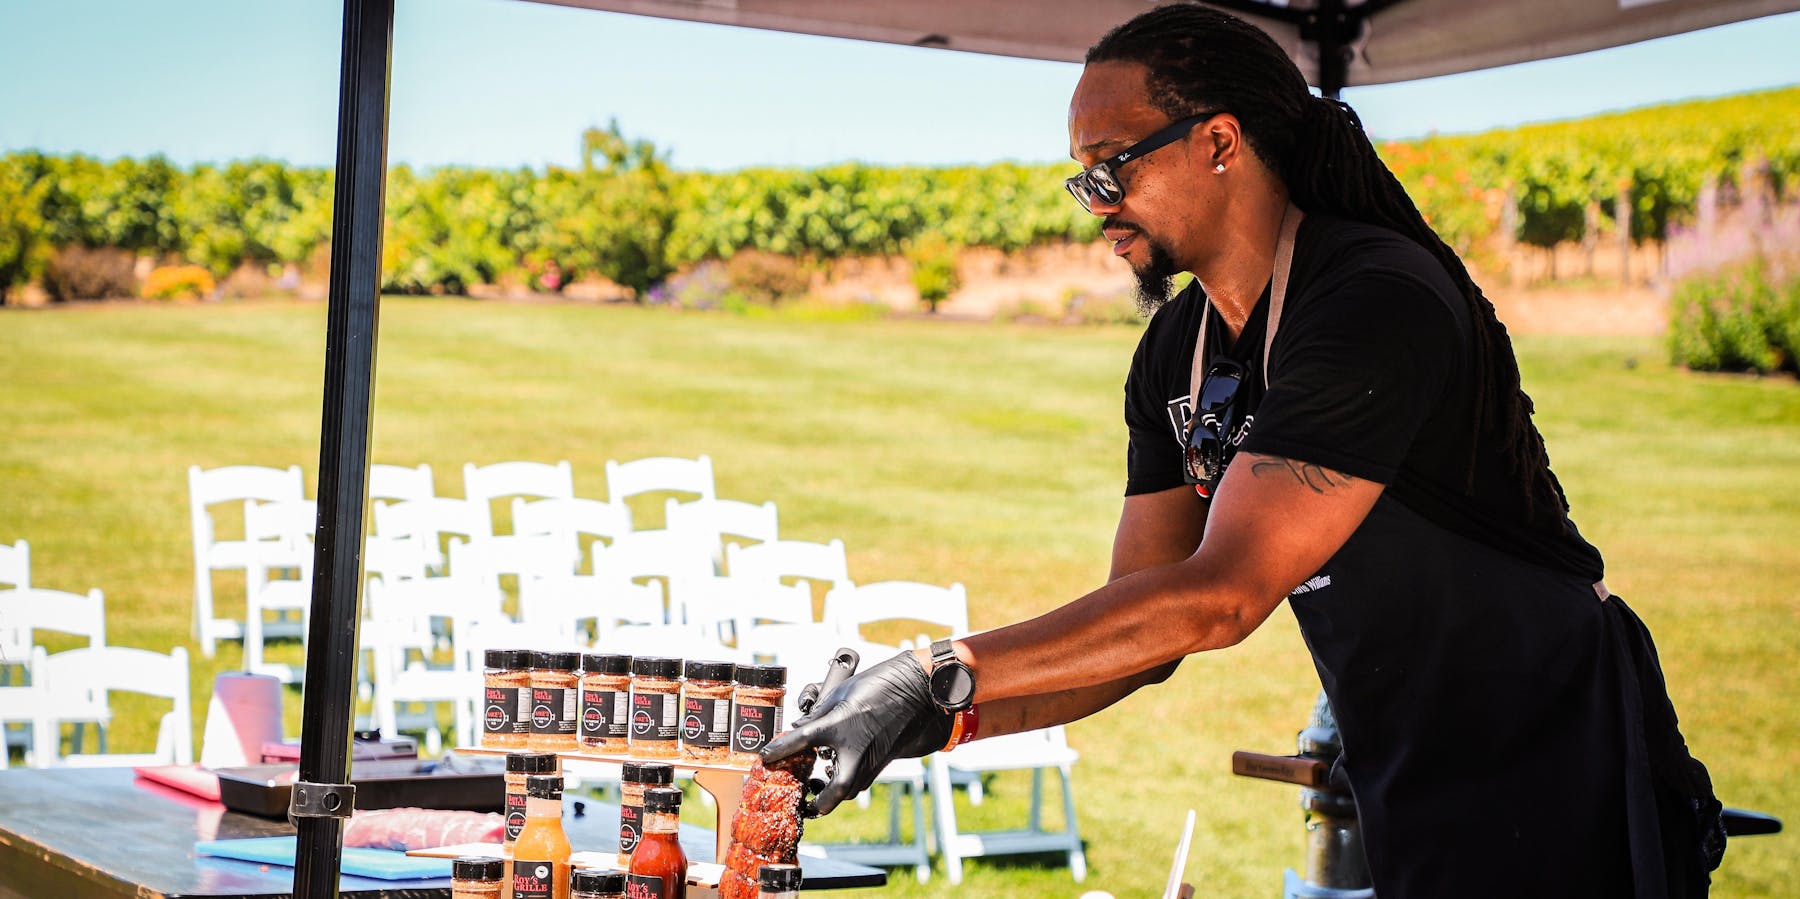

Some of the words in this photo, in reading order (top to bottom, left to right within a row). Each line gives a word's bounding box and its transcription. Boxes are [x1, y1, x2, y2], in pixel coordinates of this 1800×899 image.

[514, 874, 539, 885] ROY'S
[514, 882, 548, 892] GRILLE
[627, 881, 649, 893] ROY'S
